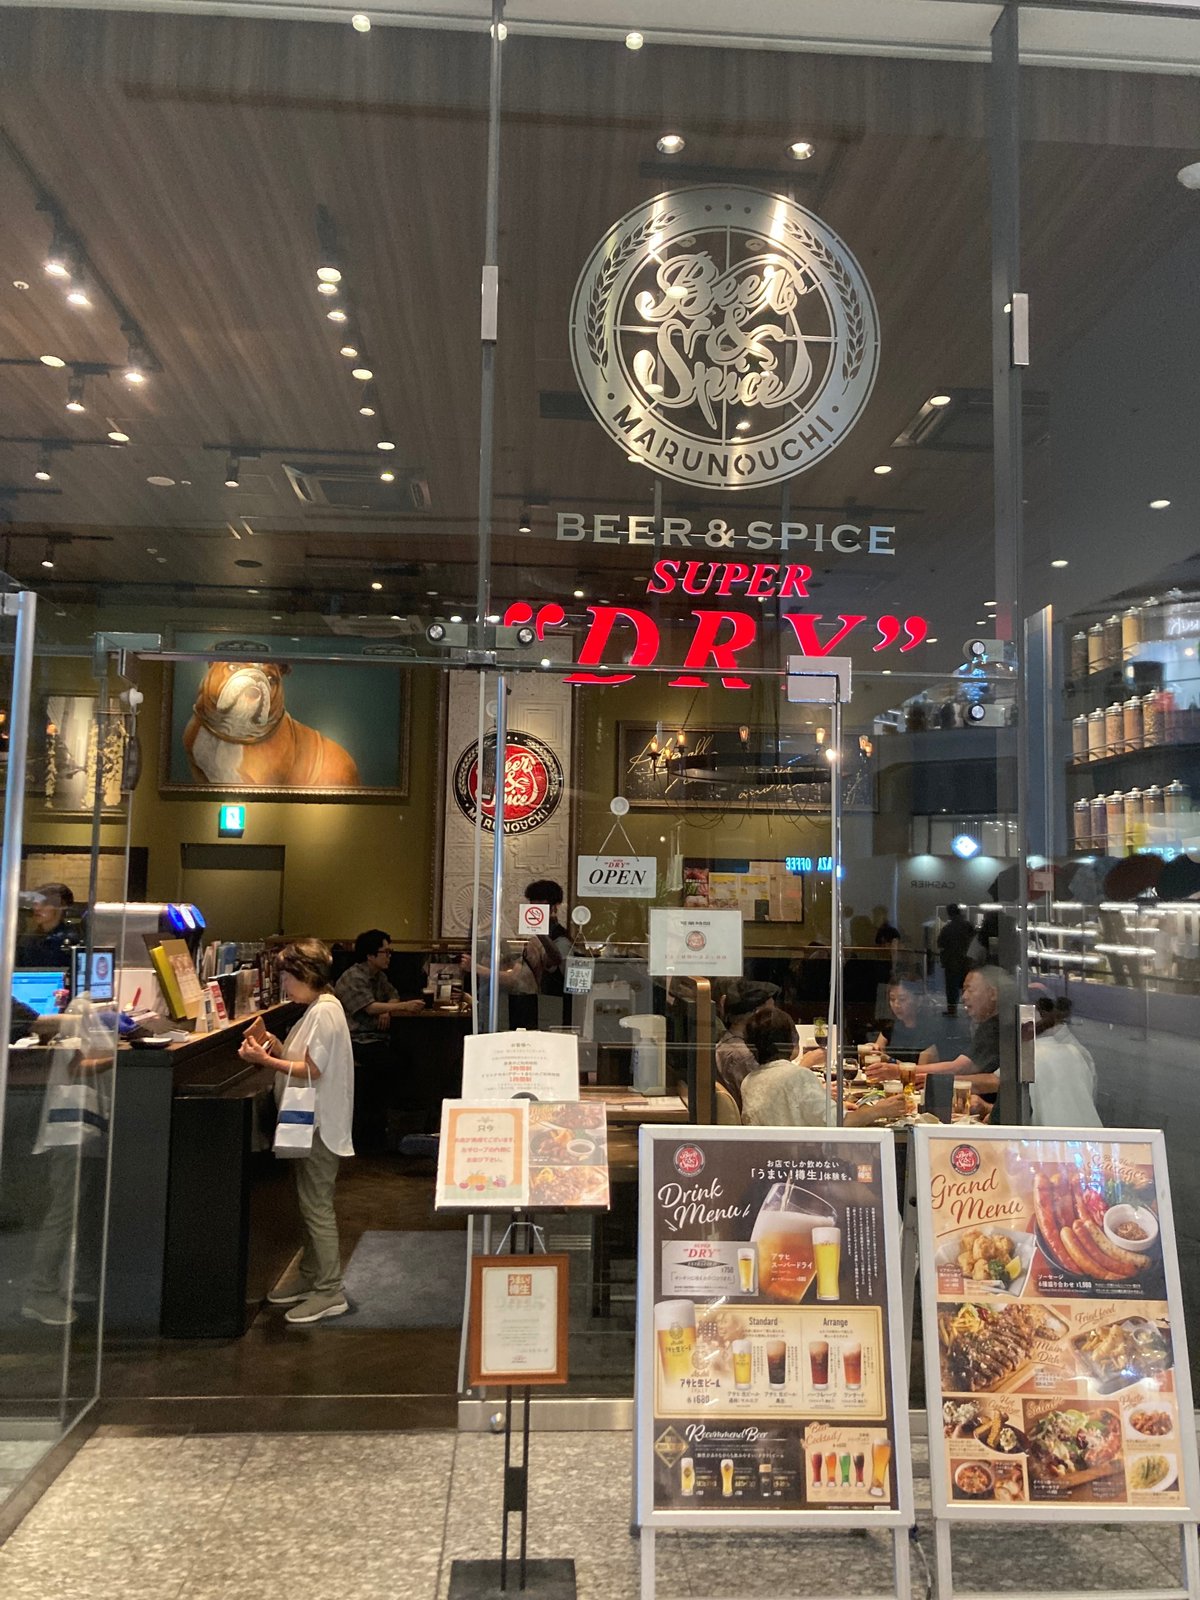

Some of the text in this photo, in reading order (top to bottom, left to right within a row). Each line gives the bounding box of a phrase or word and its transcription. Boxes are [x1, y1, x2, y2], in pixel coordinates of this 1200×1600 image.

[635, 251, 808, 322] Beer
[633, 318, 813, 430] Spice
[613, 404, 836, 477] MARUNOUCHI
[646, 559, 812, 598] SUPER
[467, 806, 549, 833] MRNOUCHI
[589, 868, 647, 885] OPEN
[767, 1160, 839, 1168] お店でしか飲めない
[658, 1178, 723, 1208] Drink
[931, 1168, 999, 1209] Grand
[674, 1203, 742, 1229] Menu
[951, 1197, 1023, 1224] Menu
[771, 1261, 812, 1269] スーパードライ
[749, 1317, 778, 1326] Standard
[823, 1317, 848, 1327] Arrange
[685, 1424, 768, 1441] Recommend Beer
